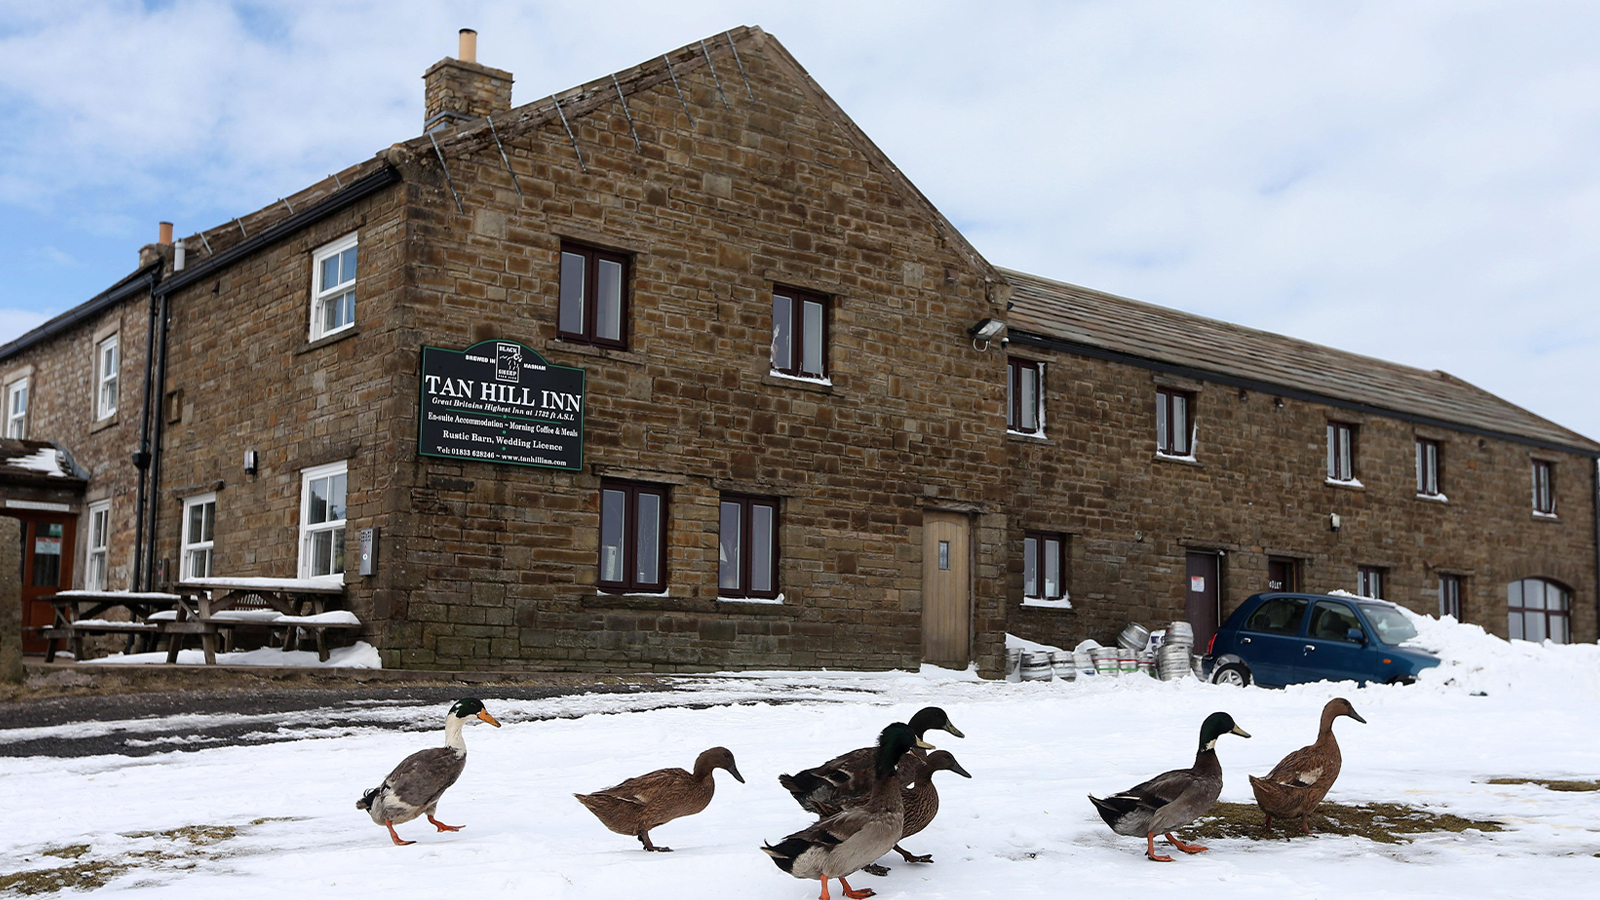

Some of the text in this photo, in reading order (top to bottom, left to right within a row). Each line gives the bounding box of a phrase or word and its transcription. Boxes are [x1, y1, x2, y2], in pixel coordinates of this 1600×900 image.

[465, 354, 488, 363] BREWED
[425, 375, 581, 412] TAN HILL INN
[432, 396, 452, 406] Great
[454, 400, 483, 409] Britains
[484, 403, 511, 412] Highest
[428, 411, 454, 422] En-suite
[455, 415, 504, 428] Accommodation
[510, 422, 535, 433] Morning
[536, 424, 554, 435] Coffee
[561, 428, 578, 437] Meals
[443, 430, 563, 451] Rustic Barn, Wedding Licence
[436, 446, 450, 454] Tel:
[451, 448, 470, 456] 01833
[472, 450, 494, 458] 628246
[502, 454, 567, 466] www.tanhillinn.com
